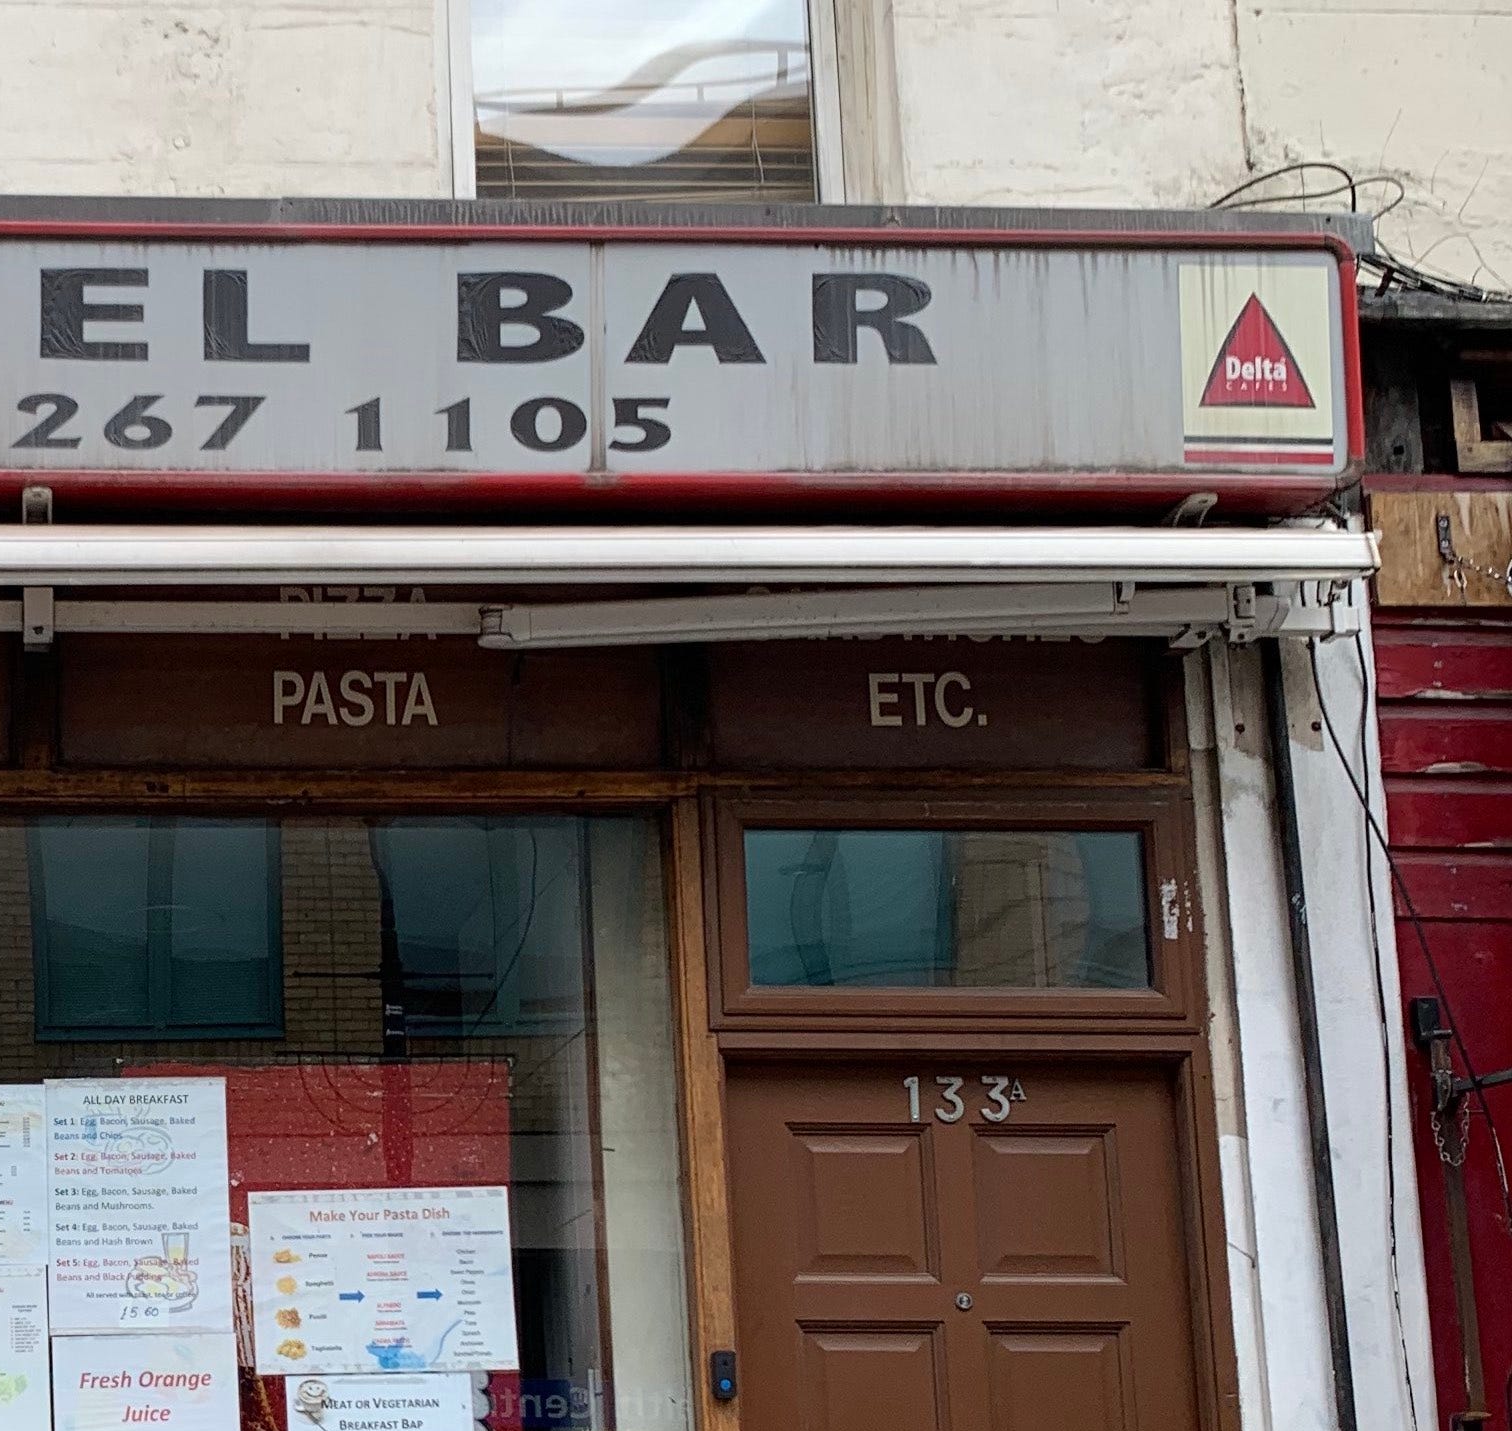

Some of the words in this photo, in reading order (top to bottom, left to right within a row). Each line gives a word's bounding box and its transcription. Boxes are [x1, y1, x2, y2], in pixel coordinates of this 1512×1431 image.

[456, 270, 937, 366] BAR
[1226, 356, 1287, 381] Delta
[346, 396, 674, 454] 1105
[273, 670, 438, 727] PASTA
[868, 671, 988, 727] ETC.
[83, 1096, 101, 1105] ALL
[104, 1095, 125, 1105] DAY
[129, 1094, 189, 1105] BREAKFAST
[53, 1118, 68, 1126] Set
[169, 1116, 196, 1125] Baked
[54, 1132, 79, 1140] Beans
[82, 1132, 97, 1140] and
[54, 1153, 69, 1161] Set
[170, 1151, 197, 1160] Baked
[54, 1167, 80, 1175] Beans
[82, 1167, 98, 1175] and
[55, 1188, 69, 1196] Set
[171, 1186, 197, 1195] Baked
[55, 1202, 81, 1210] Beans
[83, 1202, 99, 1210] and
[309, 1209, 346, 1223] Make
[348, 1209, 379, 1222] Your
[383, 1208, 418, 1221] Pasta
[421, 1207, 450, 1220] Dish
[55, 1223, 70, 1231] Set
[172, 1222, 198, 1230] Baked
[56, 1238, 81, 1246] Beans
[84, 1237, 99, 1246] and
[102, 1237, 123, 1245] Hash
[125, 1237, 153, 1245] Brown
[56, 1259, 71, 1267] Set
[56, 1273, 82, 1281] Beans
[85, 1273, 100, 1281] and
[103, 1273, 125, 1281] Black
[128, 1273, 163, 1284] Pudding
[79, 1370, 132, 1389] Fresh
[138, 1370, 211, 1391] Orange
[372, 1397, 440, 1409] VEGETARIAN
[122, 1404, 172, 1422] Juice
[339, 1419, 398, 1431] BREAKFAST
[401, 1418, 424, 1430] BAP
